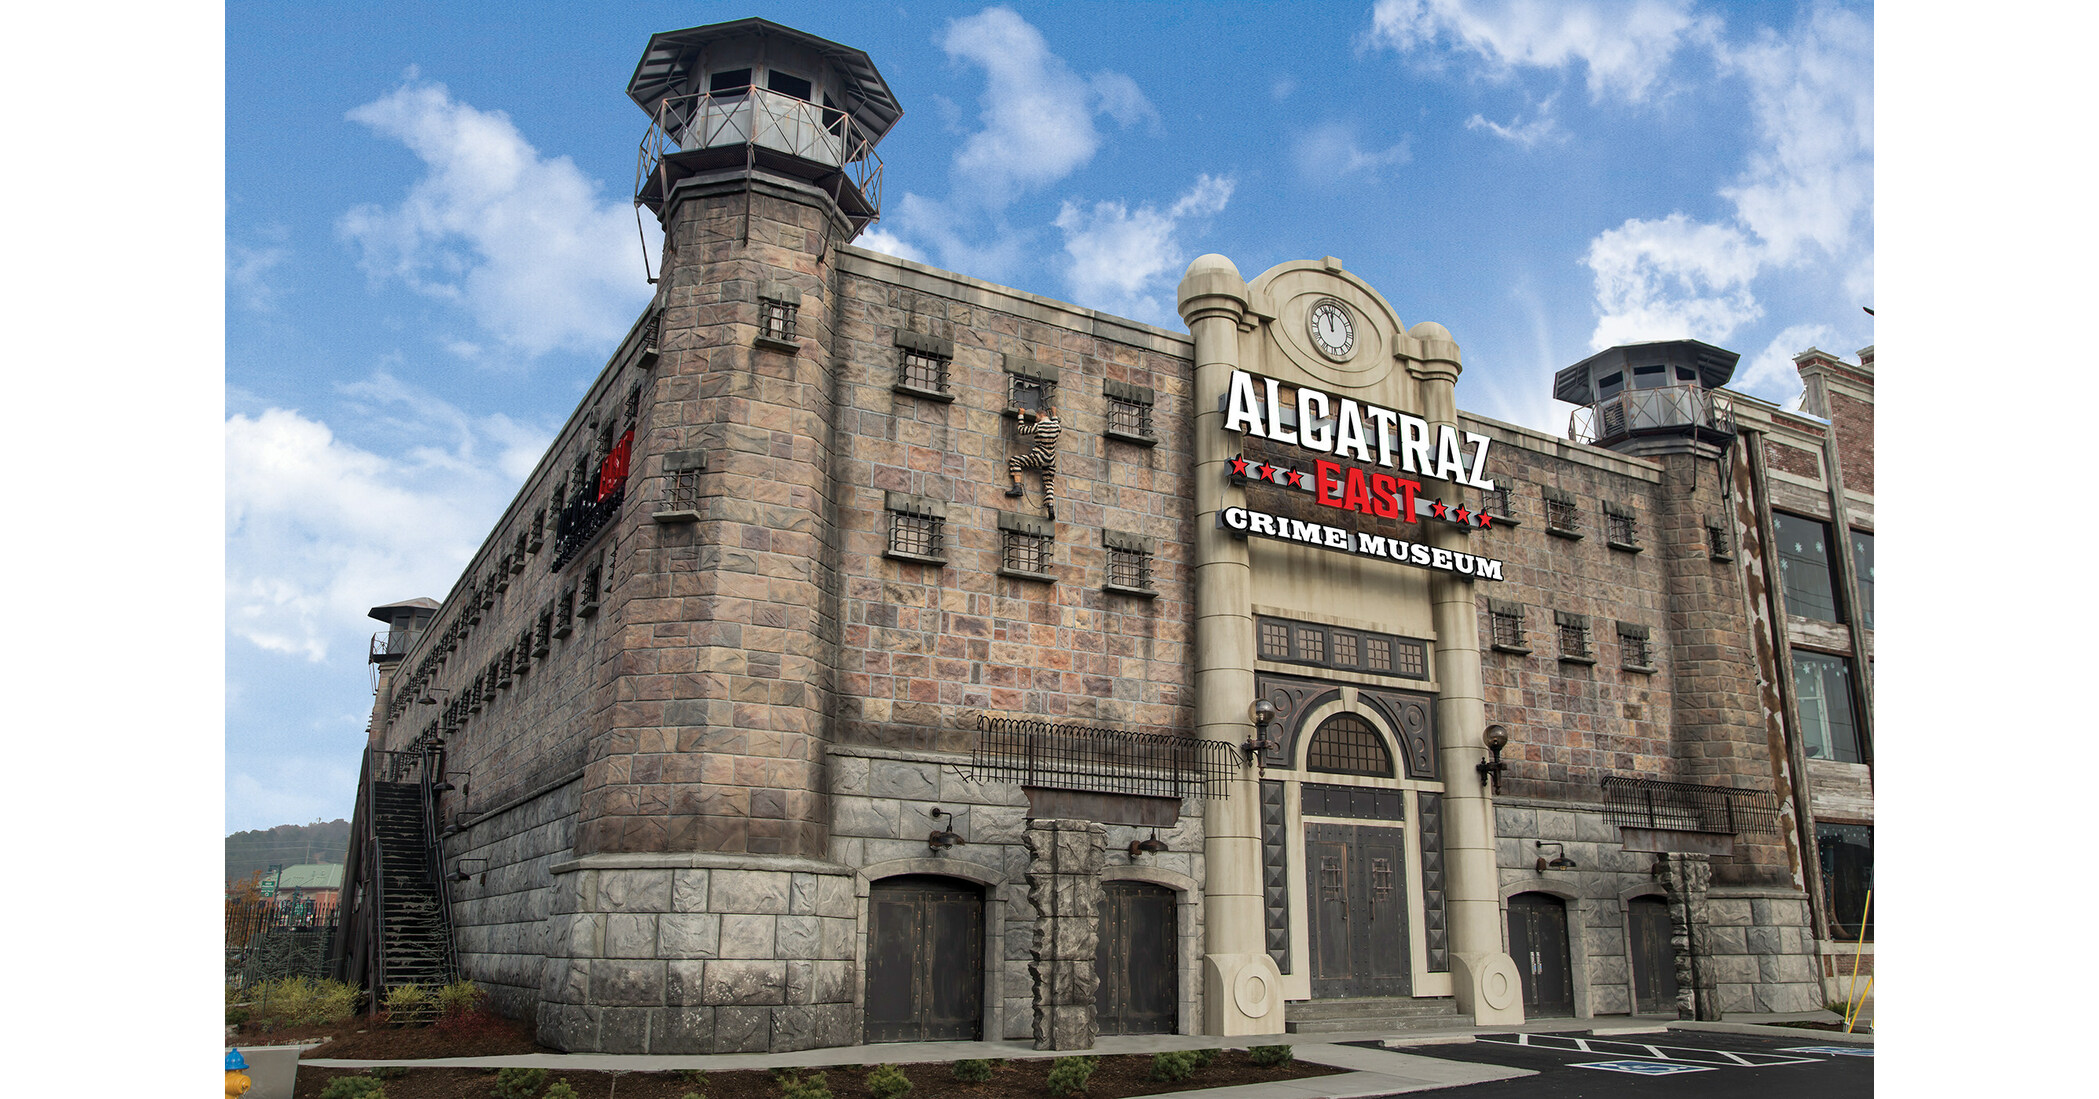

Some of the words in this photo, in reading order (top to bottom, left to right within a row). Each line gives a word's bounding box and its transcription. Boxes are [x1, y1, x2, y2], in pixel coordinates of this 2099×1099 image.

[1224, 370, 1495, 491] ALCATRAZ
[1314, 458, 1422, 524] EAST
[1225, 507, 1348, 549] CRIME
[1358, 532, 1503, 580] MUSEUM
